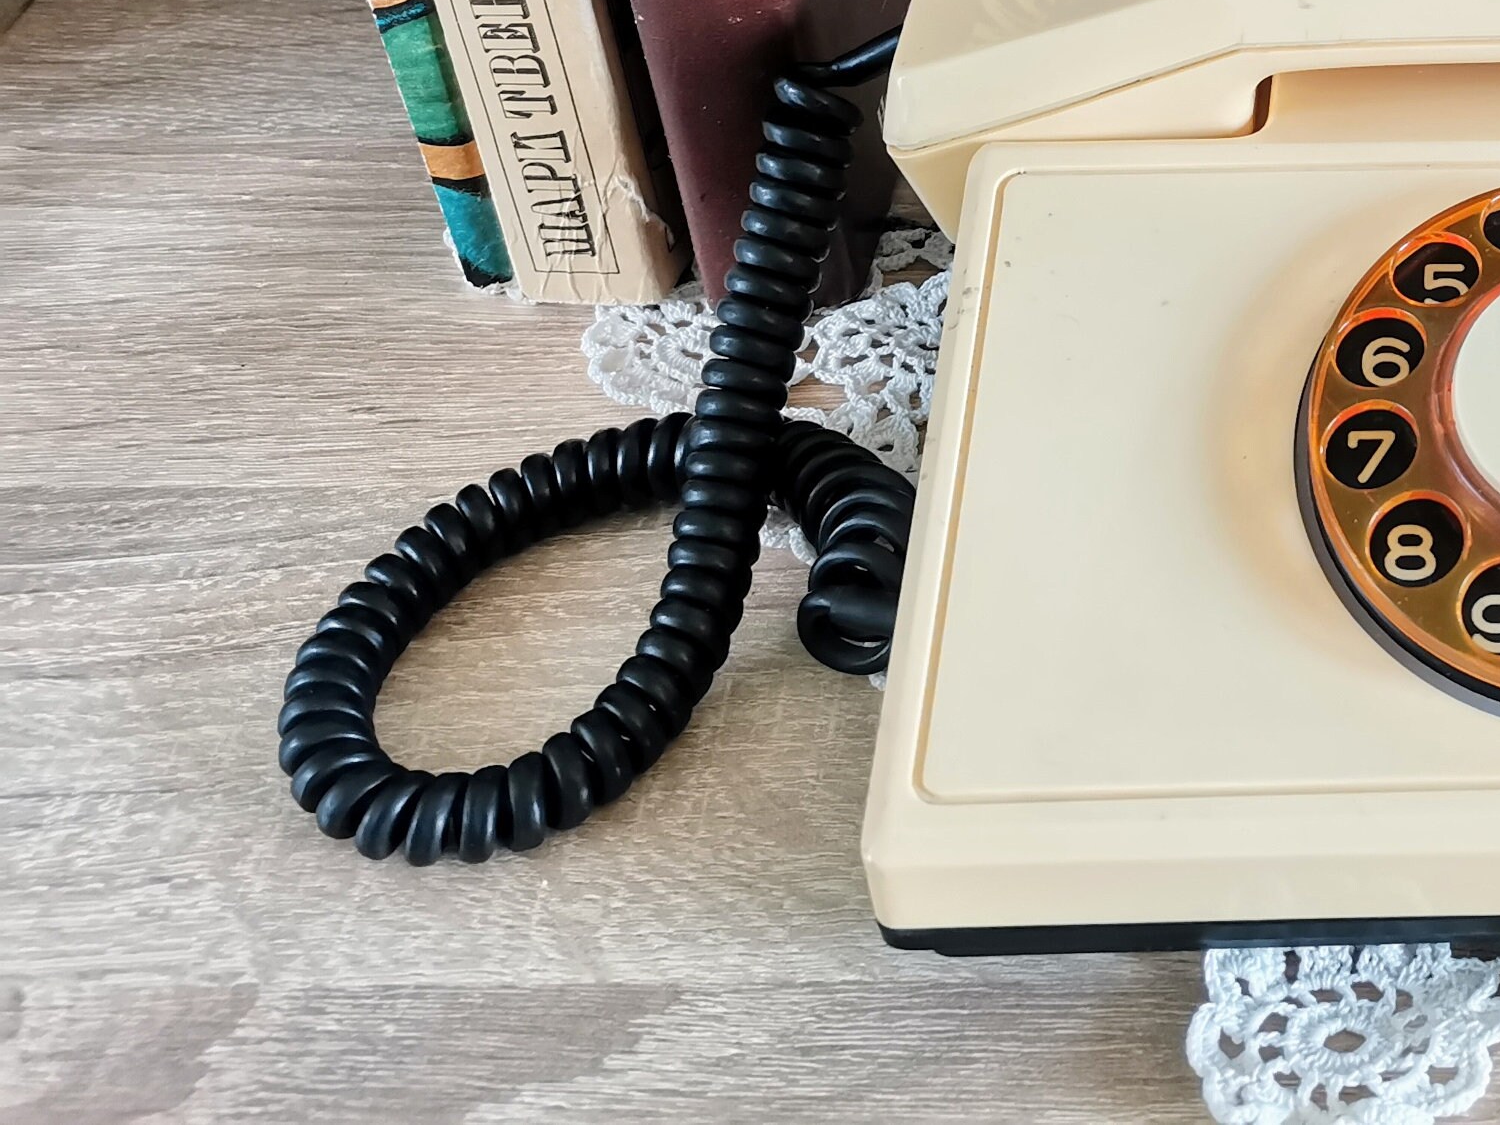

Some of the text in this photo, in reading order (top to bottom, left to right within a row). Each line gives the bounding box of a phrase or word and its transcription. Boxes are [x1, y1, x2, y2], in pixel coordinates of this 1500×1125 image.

[1424, 263, 1469, 306] 5
[1362, 337, 1411, 387] 6
[1347, 430, 1396, 483] 7
[1384, 524, 1436, 581] 8
